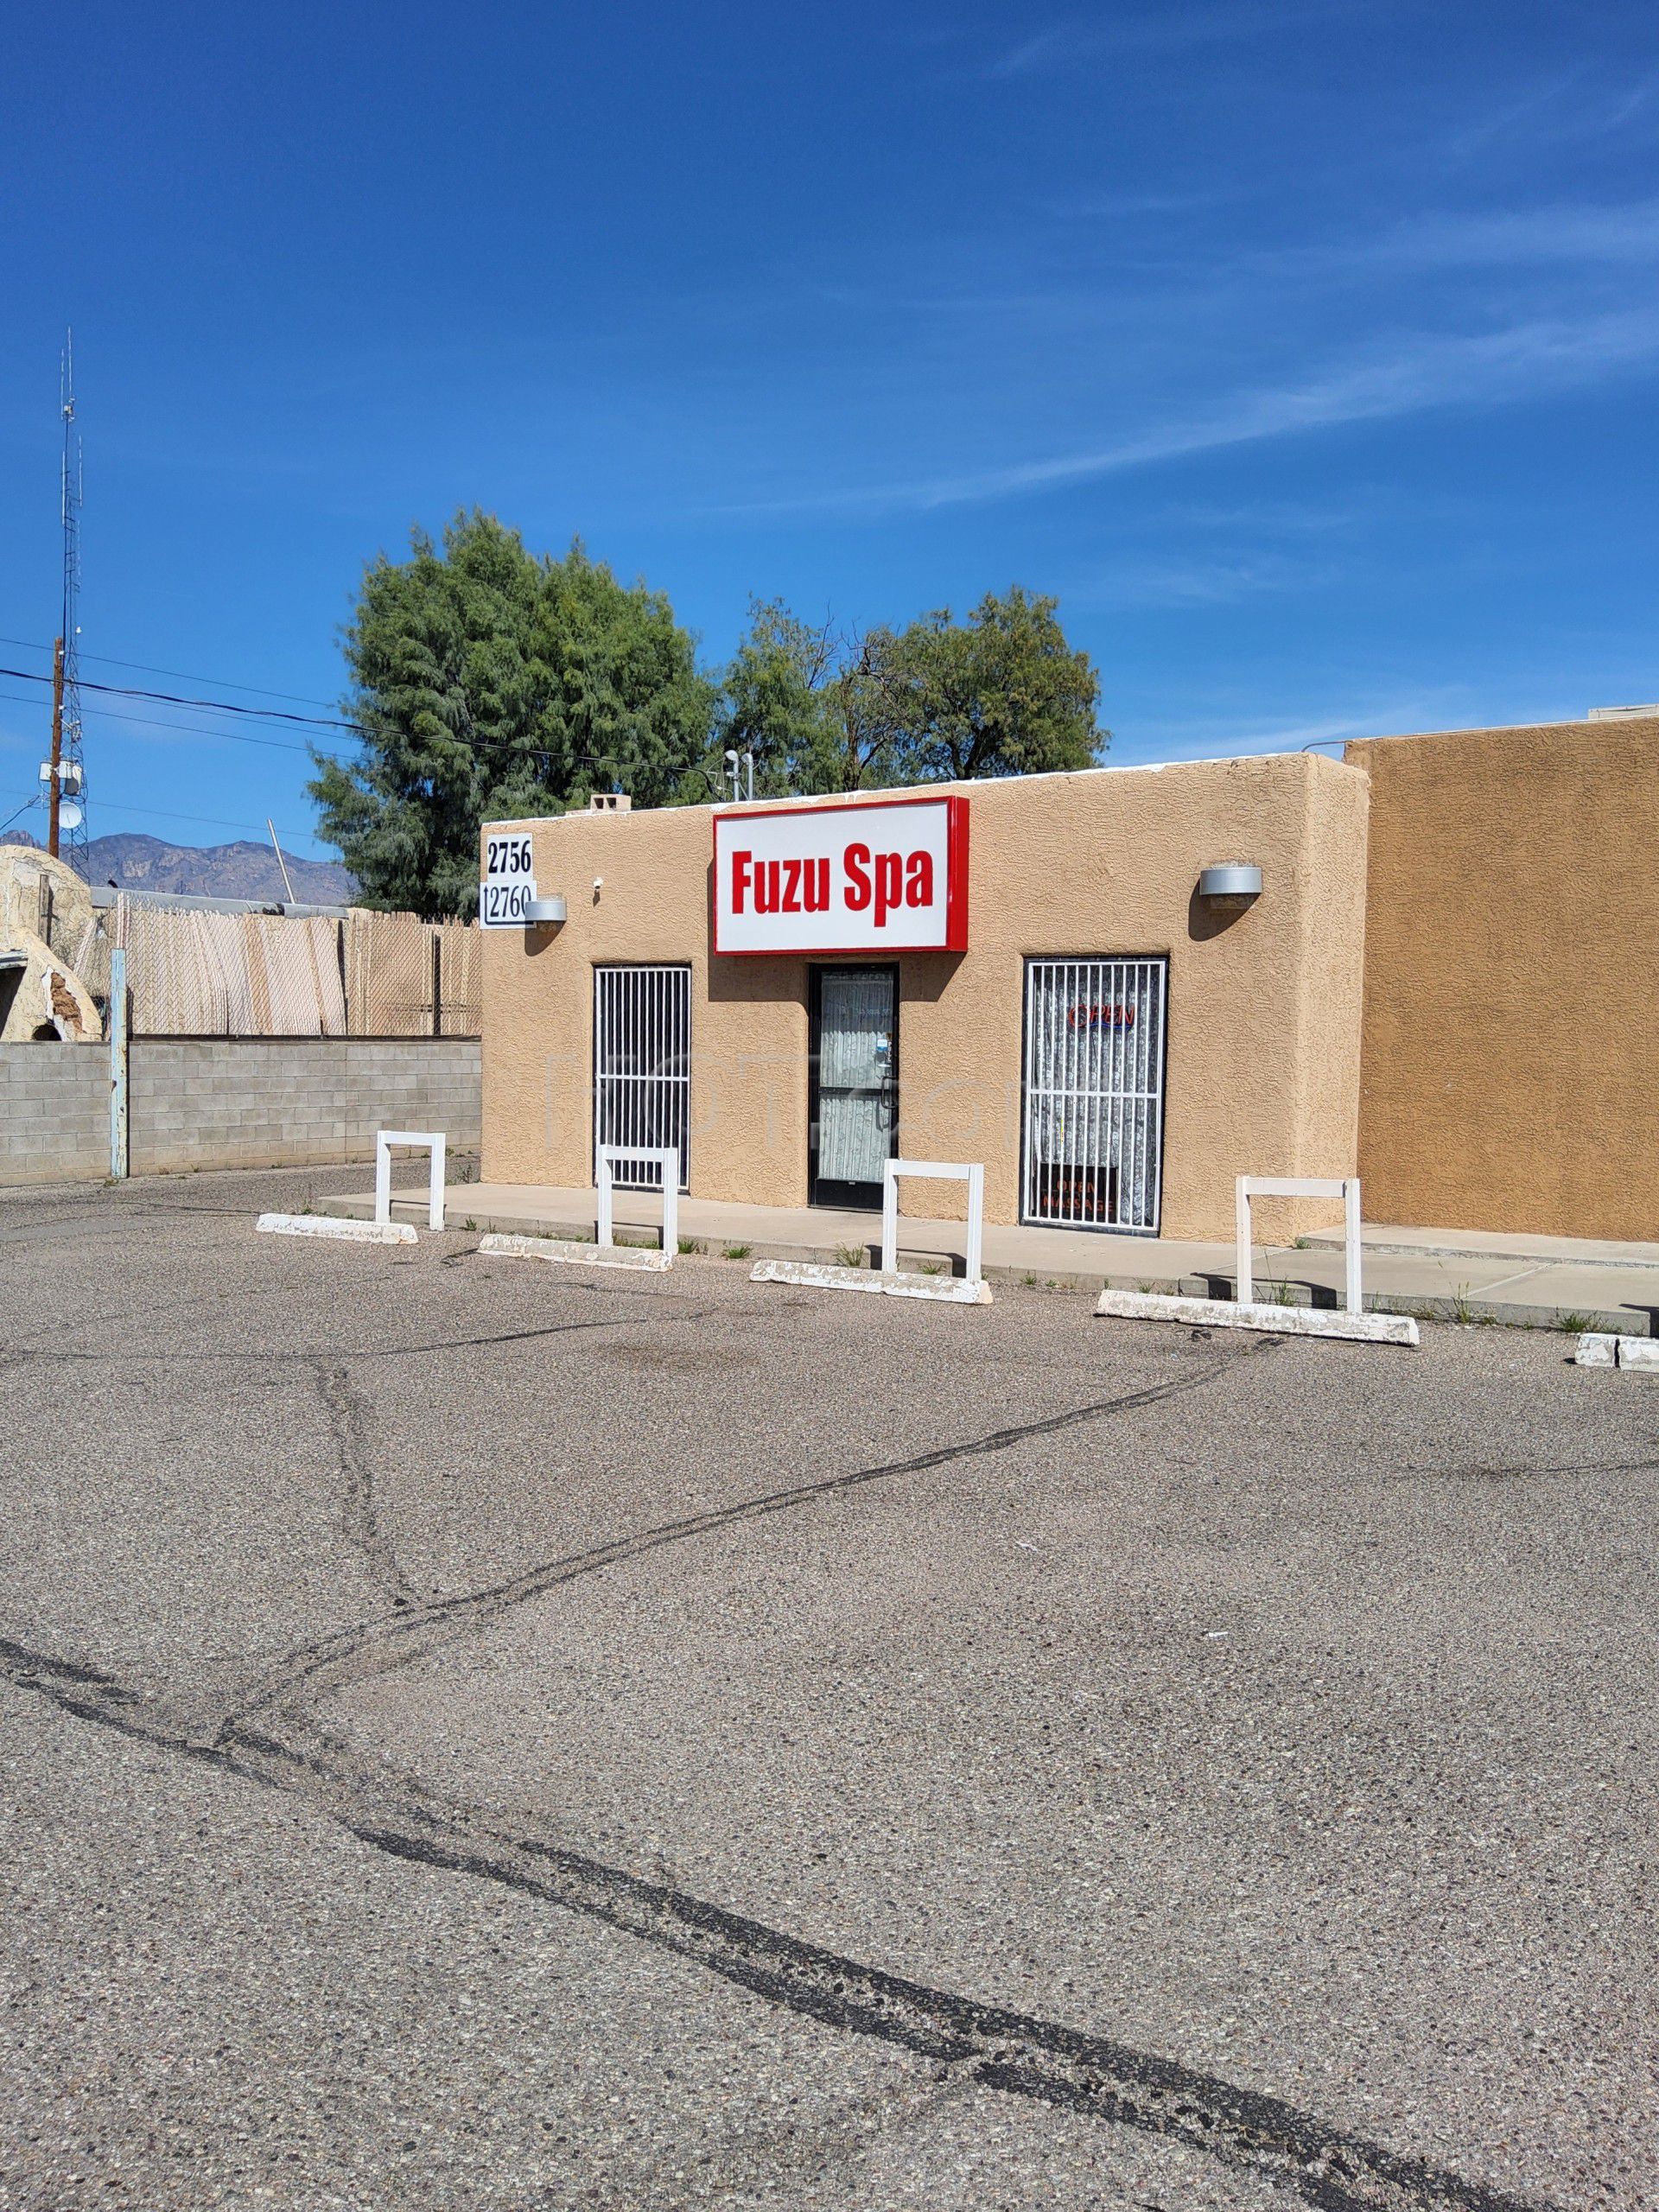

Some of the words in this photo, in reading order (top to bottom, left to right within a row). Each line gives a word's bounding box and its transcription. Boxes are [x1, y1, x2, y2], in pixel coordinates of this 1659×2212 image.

[488, 840, 531, 874] 2756
[732, 850, 830, 914] Fuzu
[843, 842, 933, 927] Spa
[490, 885, 531, 918] 2760
[1068, 1004, 1135, 1027] OPEN
[1057, 1179, 1096, 1193] OPEN
[1043, 1194, 1115, 1212] MASSAGE
